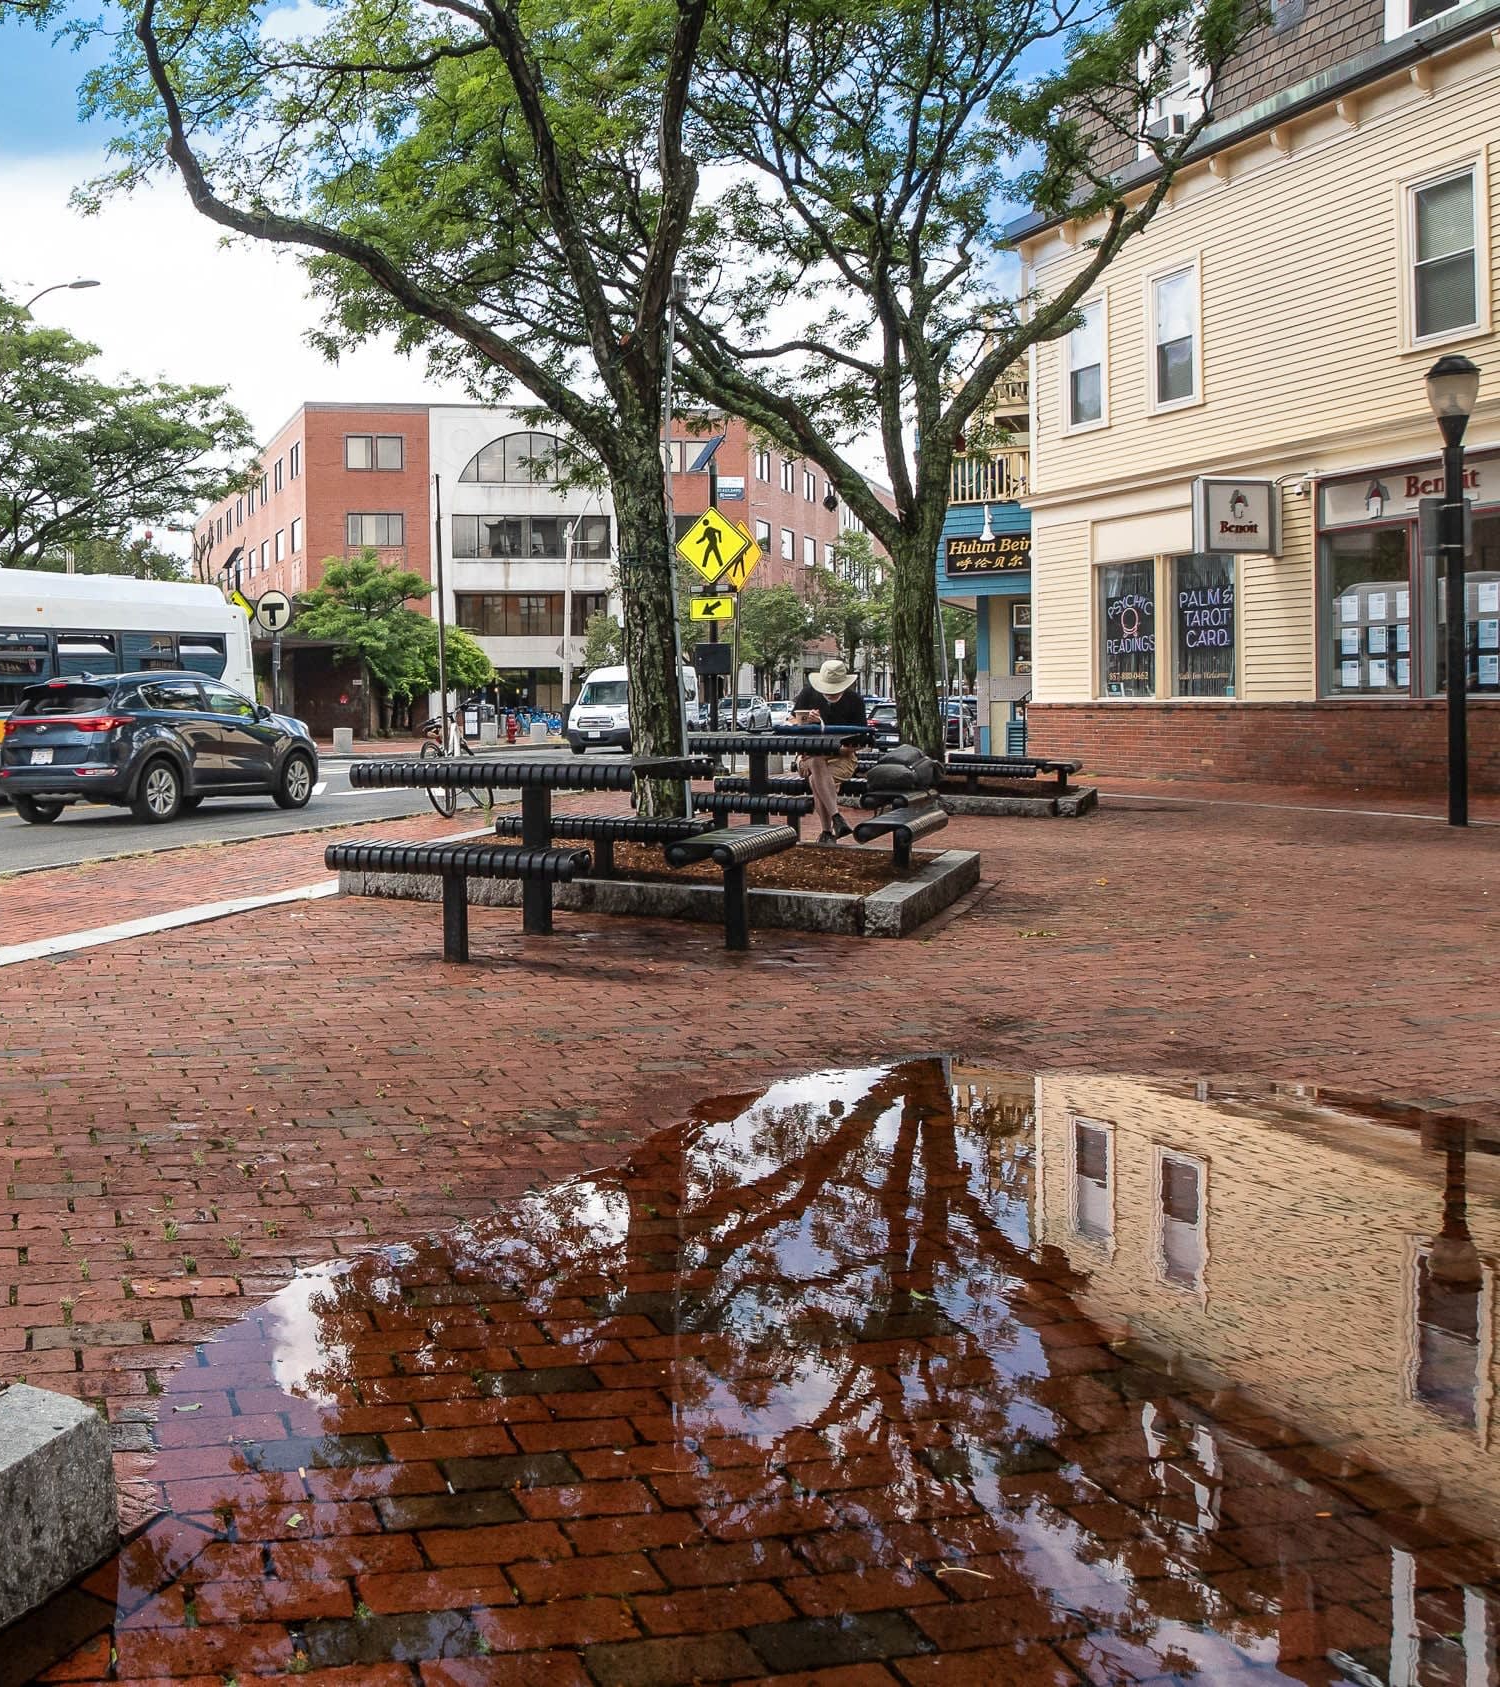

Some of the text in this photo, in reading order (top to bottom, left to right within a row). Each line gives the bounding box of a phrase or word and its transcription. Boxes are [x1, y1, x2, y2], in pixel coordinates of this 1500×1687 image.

[1404, 468, 1481, 498] Benit
[1220, 520, 1259, 534] Benoit
[949, 539, 997, 556] Hulun
[1107, 594, 1153, 620] PSYCHIC
[1179, 588, 1220, 608] PALM
[262, 602, 284, 627] T
[1183, 607, 1231, 627] TAROT
[1106, 634, 1156, 655] READINGS
[1186, 628, 1228, 648] CARD
